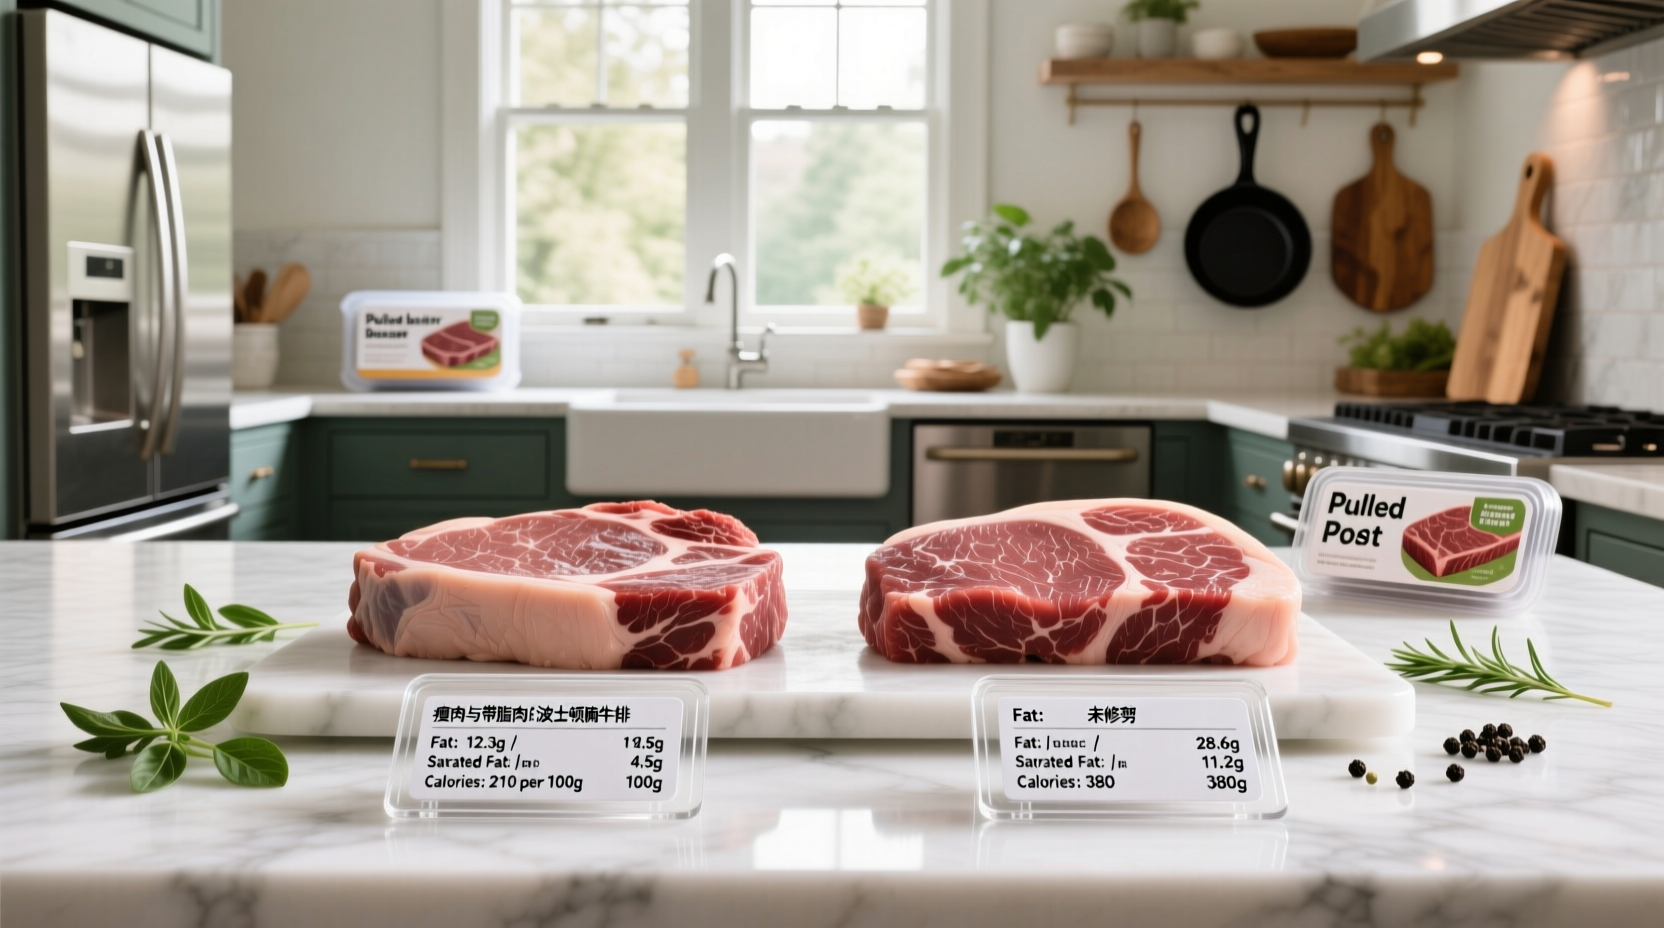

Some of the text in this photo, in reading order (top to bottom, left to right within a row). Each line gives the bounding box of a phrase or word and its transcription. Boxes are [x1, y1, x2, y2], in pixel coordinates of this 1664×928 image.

[1328, 491, 1407, 520] Pulled
[1322, 520, 1383, 547] Post
[1013, 708, 1043, 722] Fat:
[431, 736, 457, 748] Fat:
[467, 736, 505, 752] 12.3g
[1015, 736, 1041, 748] Fat:
[1196, 736, 1239, 753] 28.6g
[631, 755, 662, 772] 4.5g
[1078, 756, 1104, 768] Fat:
[1202, 755, 1244, 772] 11.2g
[425, 775, 662, 793] Calories: 210 per 100g 100g
[1017, 775, 1247, 793] Calories: 380 380g
